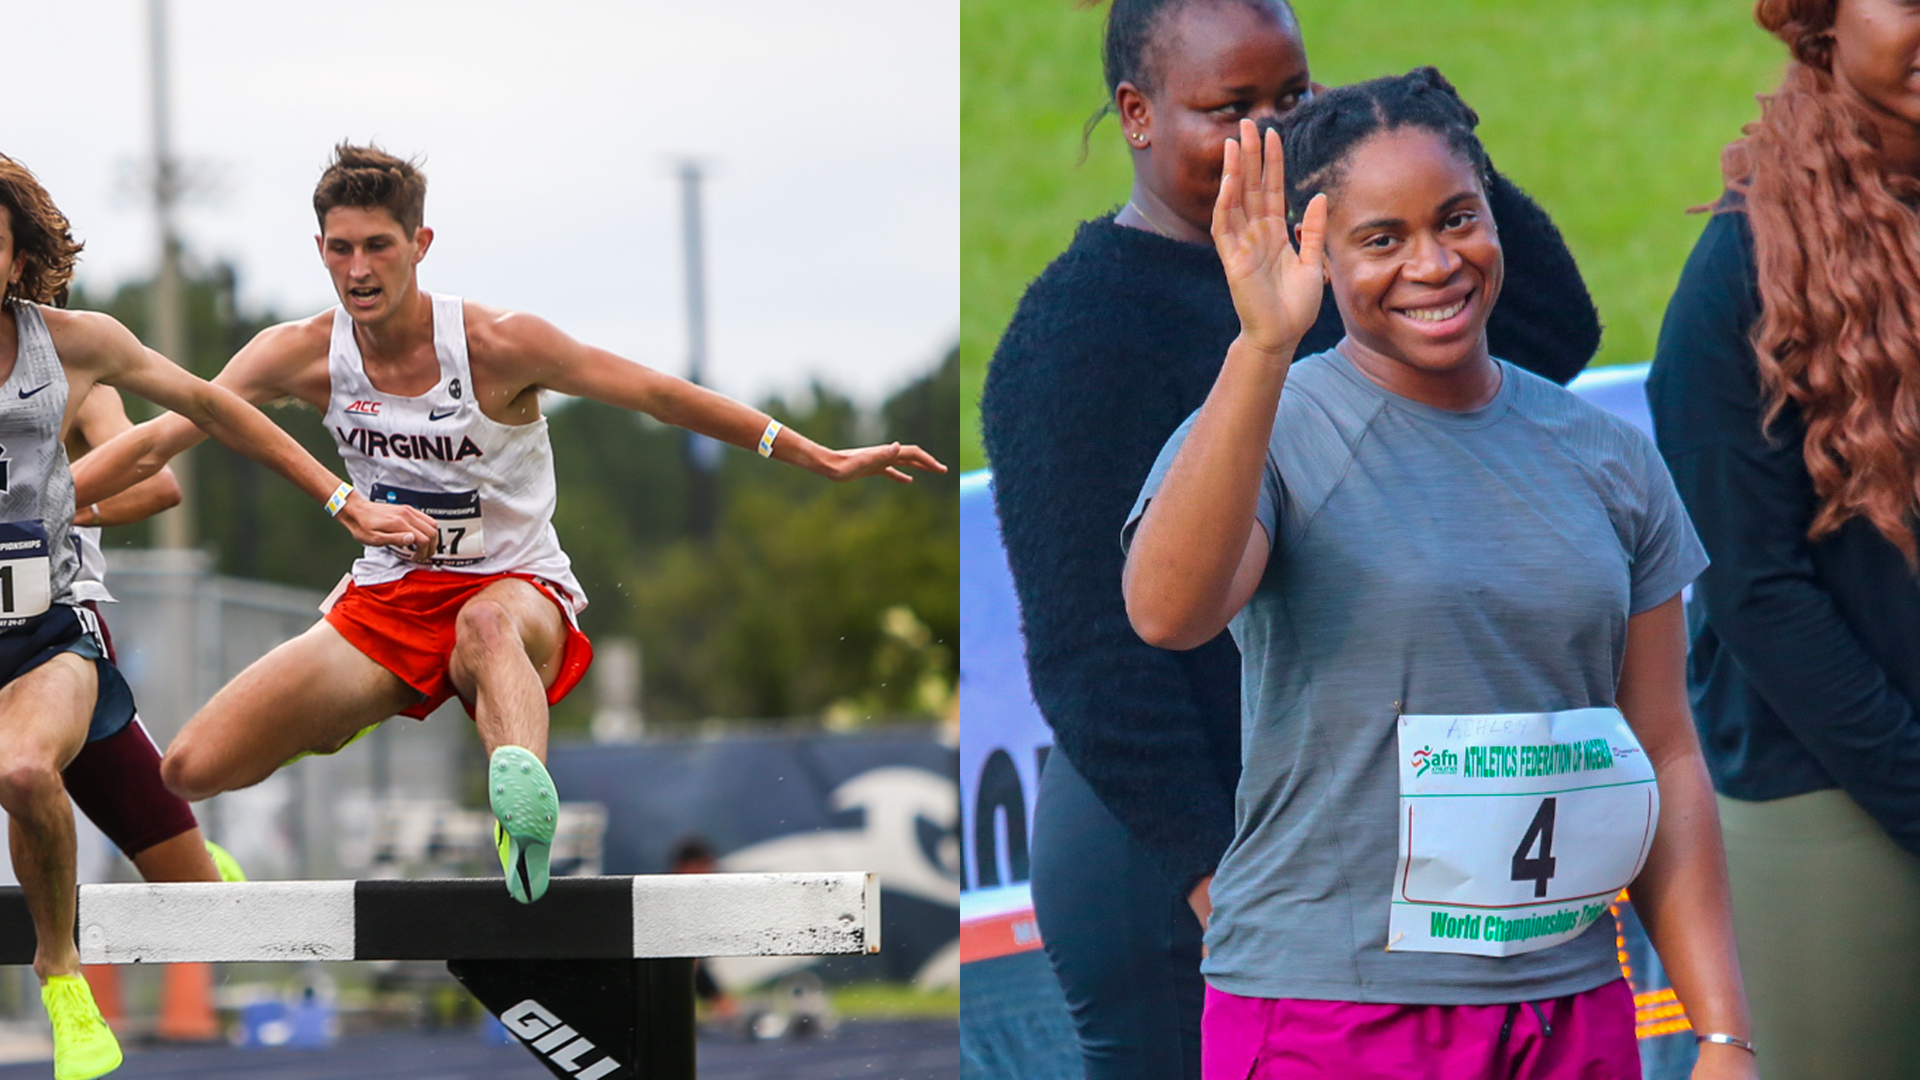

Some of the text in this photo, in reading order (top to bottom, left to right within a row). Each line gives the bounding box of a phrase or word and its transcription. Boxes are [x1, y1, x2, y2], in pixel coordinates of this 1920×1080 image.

[346, 400, 382, 413] ACC
[336, 426, 483, 461] VIRGINIA
[0, 540, 41, 551] PIONSHIPS
[1431, 749, 1458, 766] afn
[1464, 739, 1613, 778] ATHLETICS FEDERATION OF NIGERIA
[1511, 797, 1556, 897] 4
[1430, 911, 1482, 941] World
[1483, 908, 1580, 943] Championships
